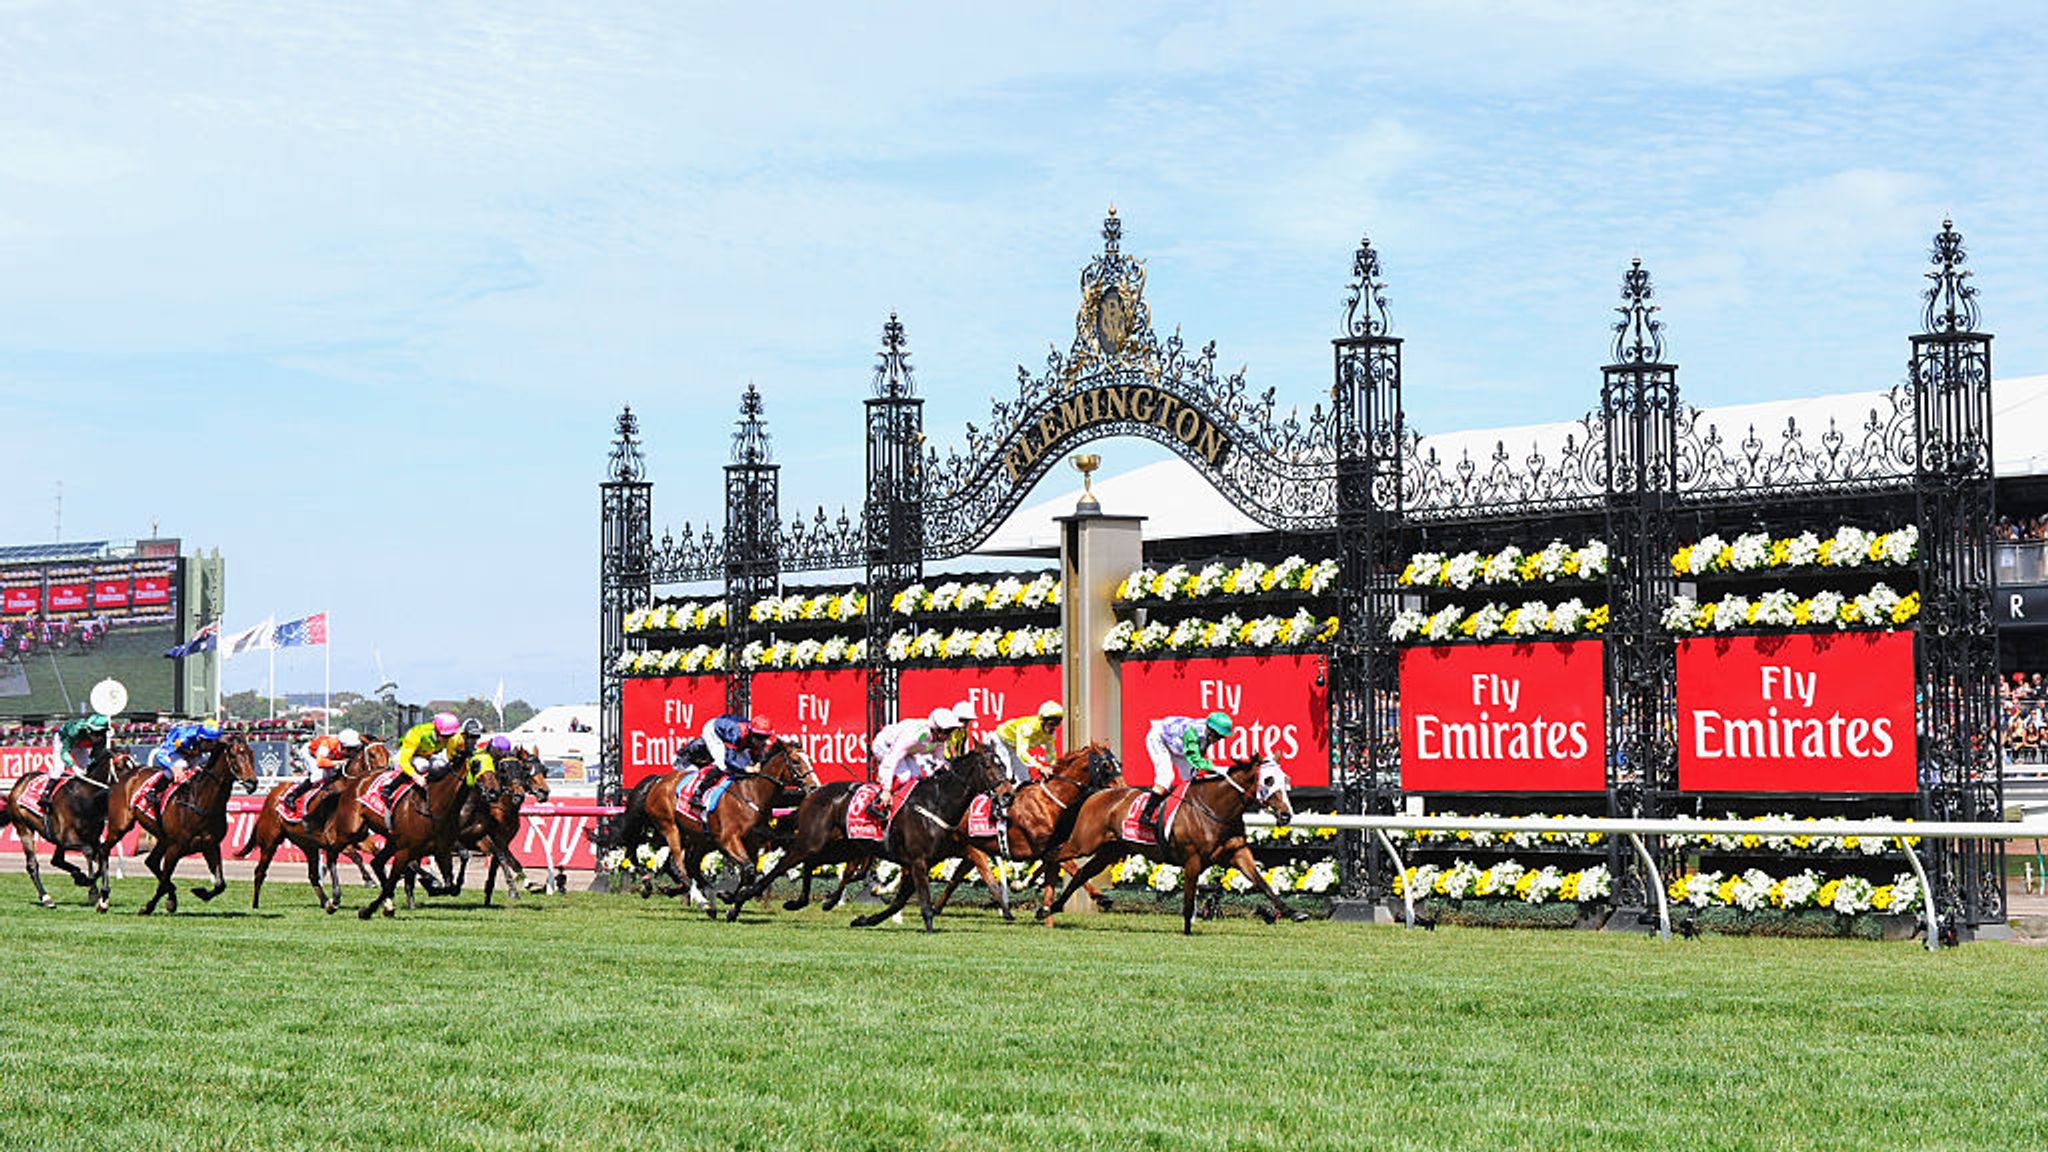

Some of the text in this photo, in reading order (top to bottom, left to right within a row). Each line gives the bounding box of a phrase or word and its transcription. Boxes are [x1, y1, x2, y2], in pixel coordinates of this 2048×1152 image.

[1003, 386, 1227, 482] FLEMINGTON
[2010, 594, 2025, 619] R
[968, 687, 1004, 721] Fly
[1200, 679, 1241, 715] Fly
[1472, 673, 1520, 711] Fly
[1760, 666, 1817, 706] Fly
[665, 699, 693, 729] Fly
[798, 694, 829, 725] Fly
[1415, 710, 1588, 760] Emirates
[1692, 706, 1893, 758] Emirates
